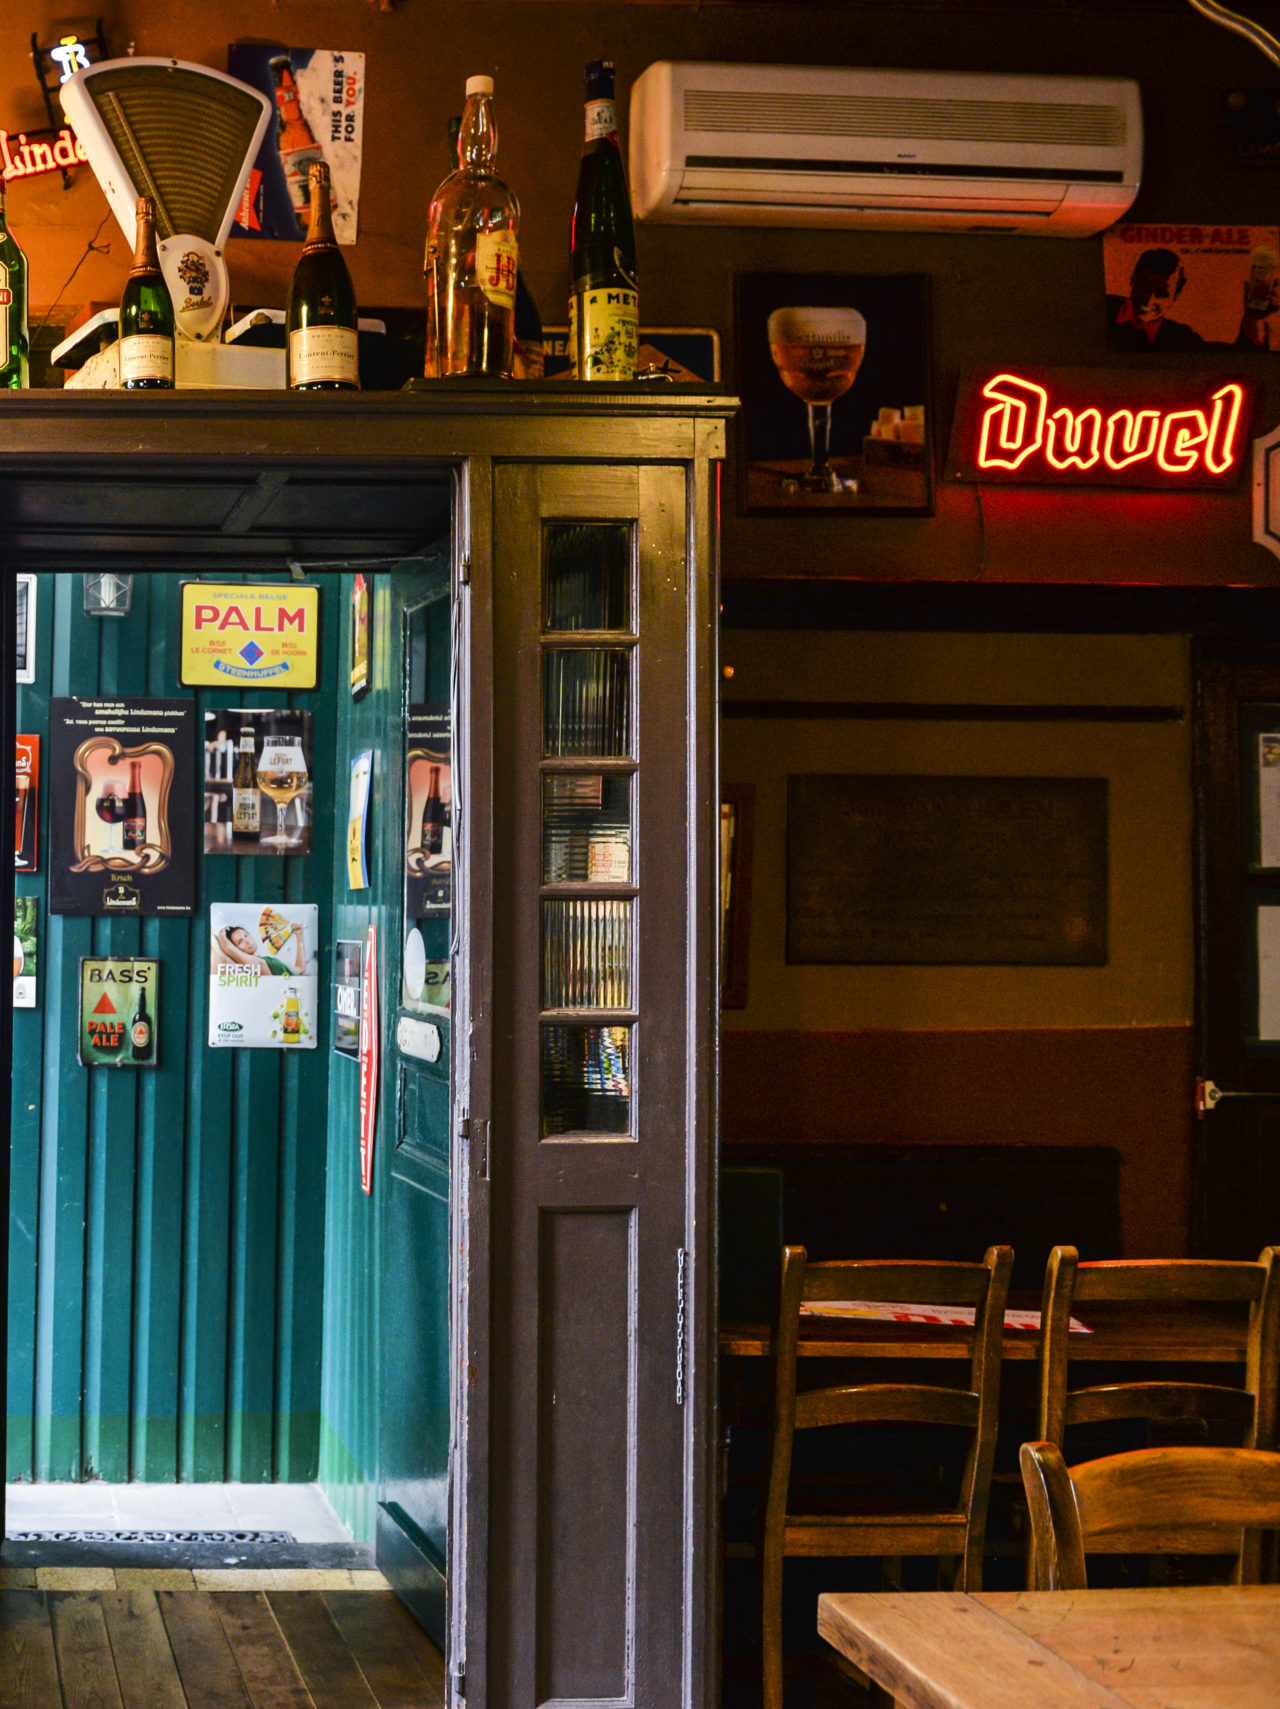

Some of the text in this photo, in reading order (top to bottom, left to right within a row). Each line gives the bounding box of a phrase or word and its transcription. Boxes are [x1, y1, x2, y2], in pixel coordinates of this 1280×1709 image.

[331, 52, 346, 143] THIS BEER'S
[344, 71, 358, 143] FOR YOU.
[1121, 226, 1251, 245] GINDER-ALE
[978, 374, 1244, 474] Duvel
[213, 592, 288, 601] SPECIALE BELGE
[194, 604, 306, 633] PALM
[202, 647, 233, 655] CORNET
[130, 708, 164, 716] Lindemans
[89, 968, 148, 984] BASS
[217, 963, 262, 976] FRESH
[218, 975, 259, 987] SPIRIT
[87, 1021, 125, 1033] PALE
[91, 1034, 120, 1047] ALE
